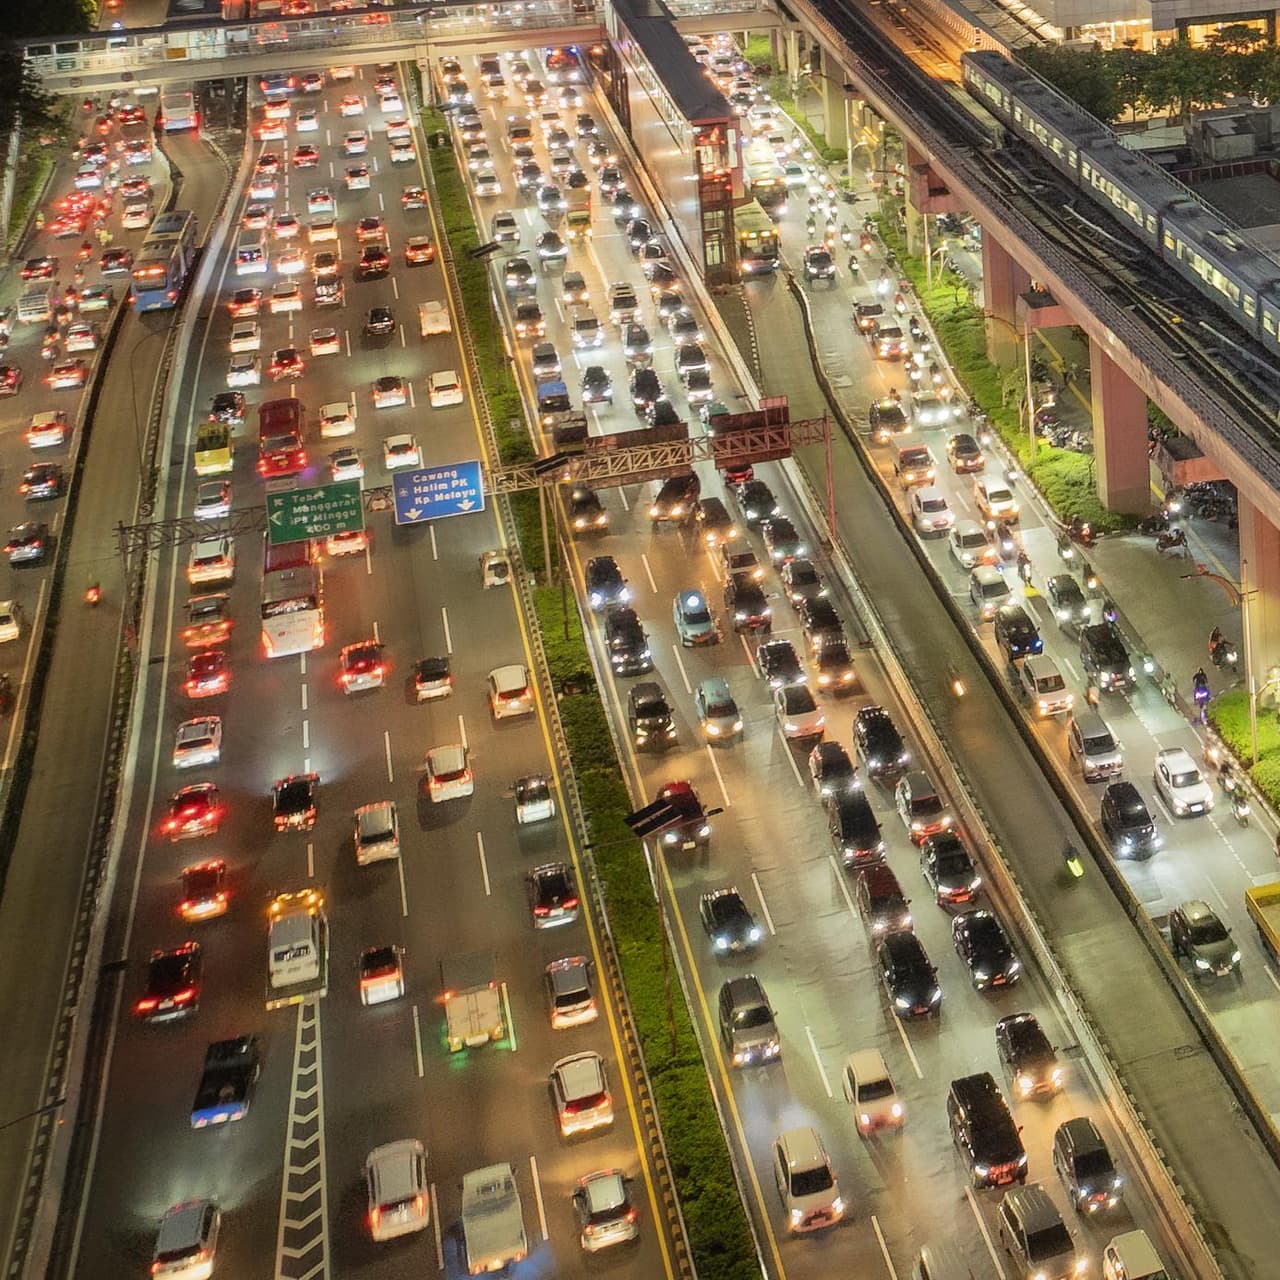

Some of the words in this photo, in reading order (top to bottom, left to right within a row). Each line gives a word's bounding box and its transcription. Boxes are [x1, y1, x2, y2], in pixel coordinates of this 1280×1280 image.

[413, 470, 457, 483] Cawang
[414, 483, 448, 494] Halim
[452, 478, 468, 488] PK
[313, 509, 356, 522] Minggu
